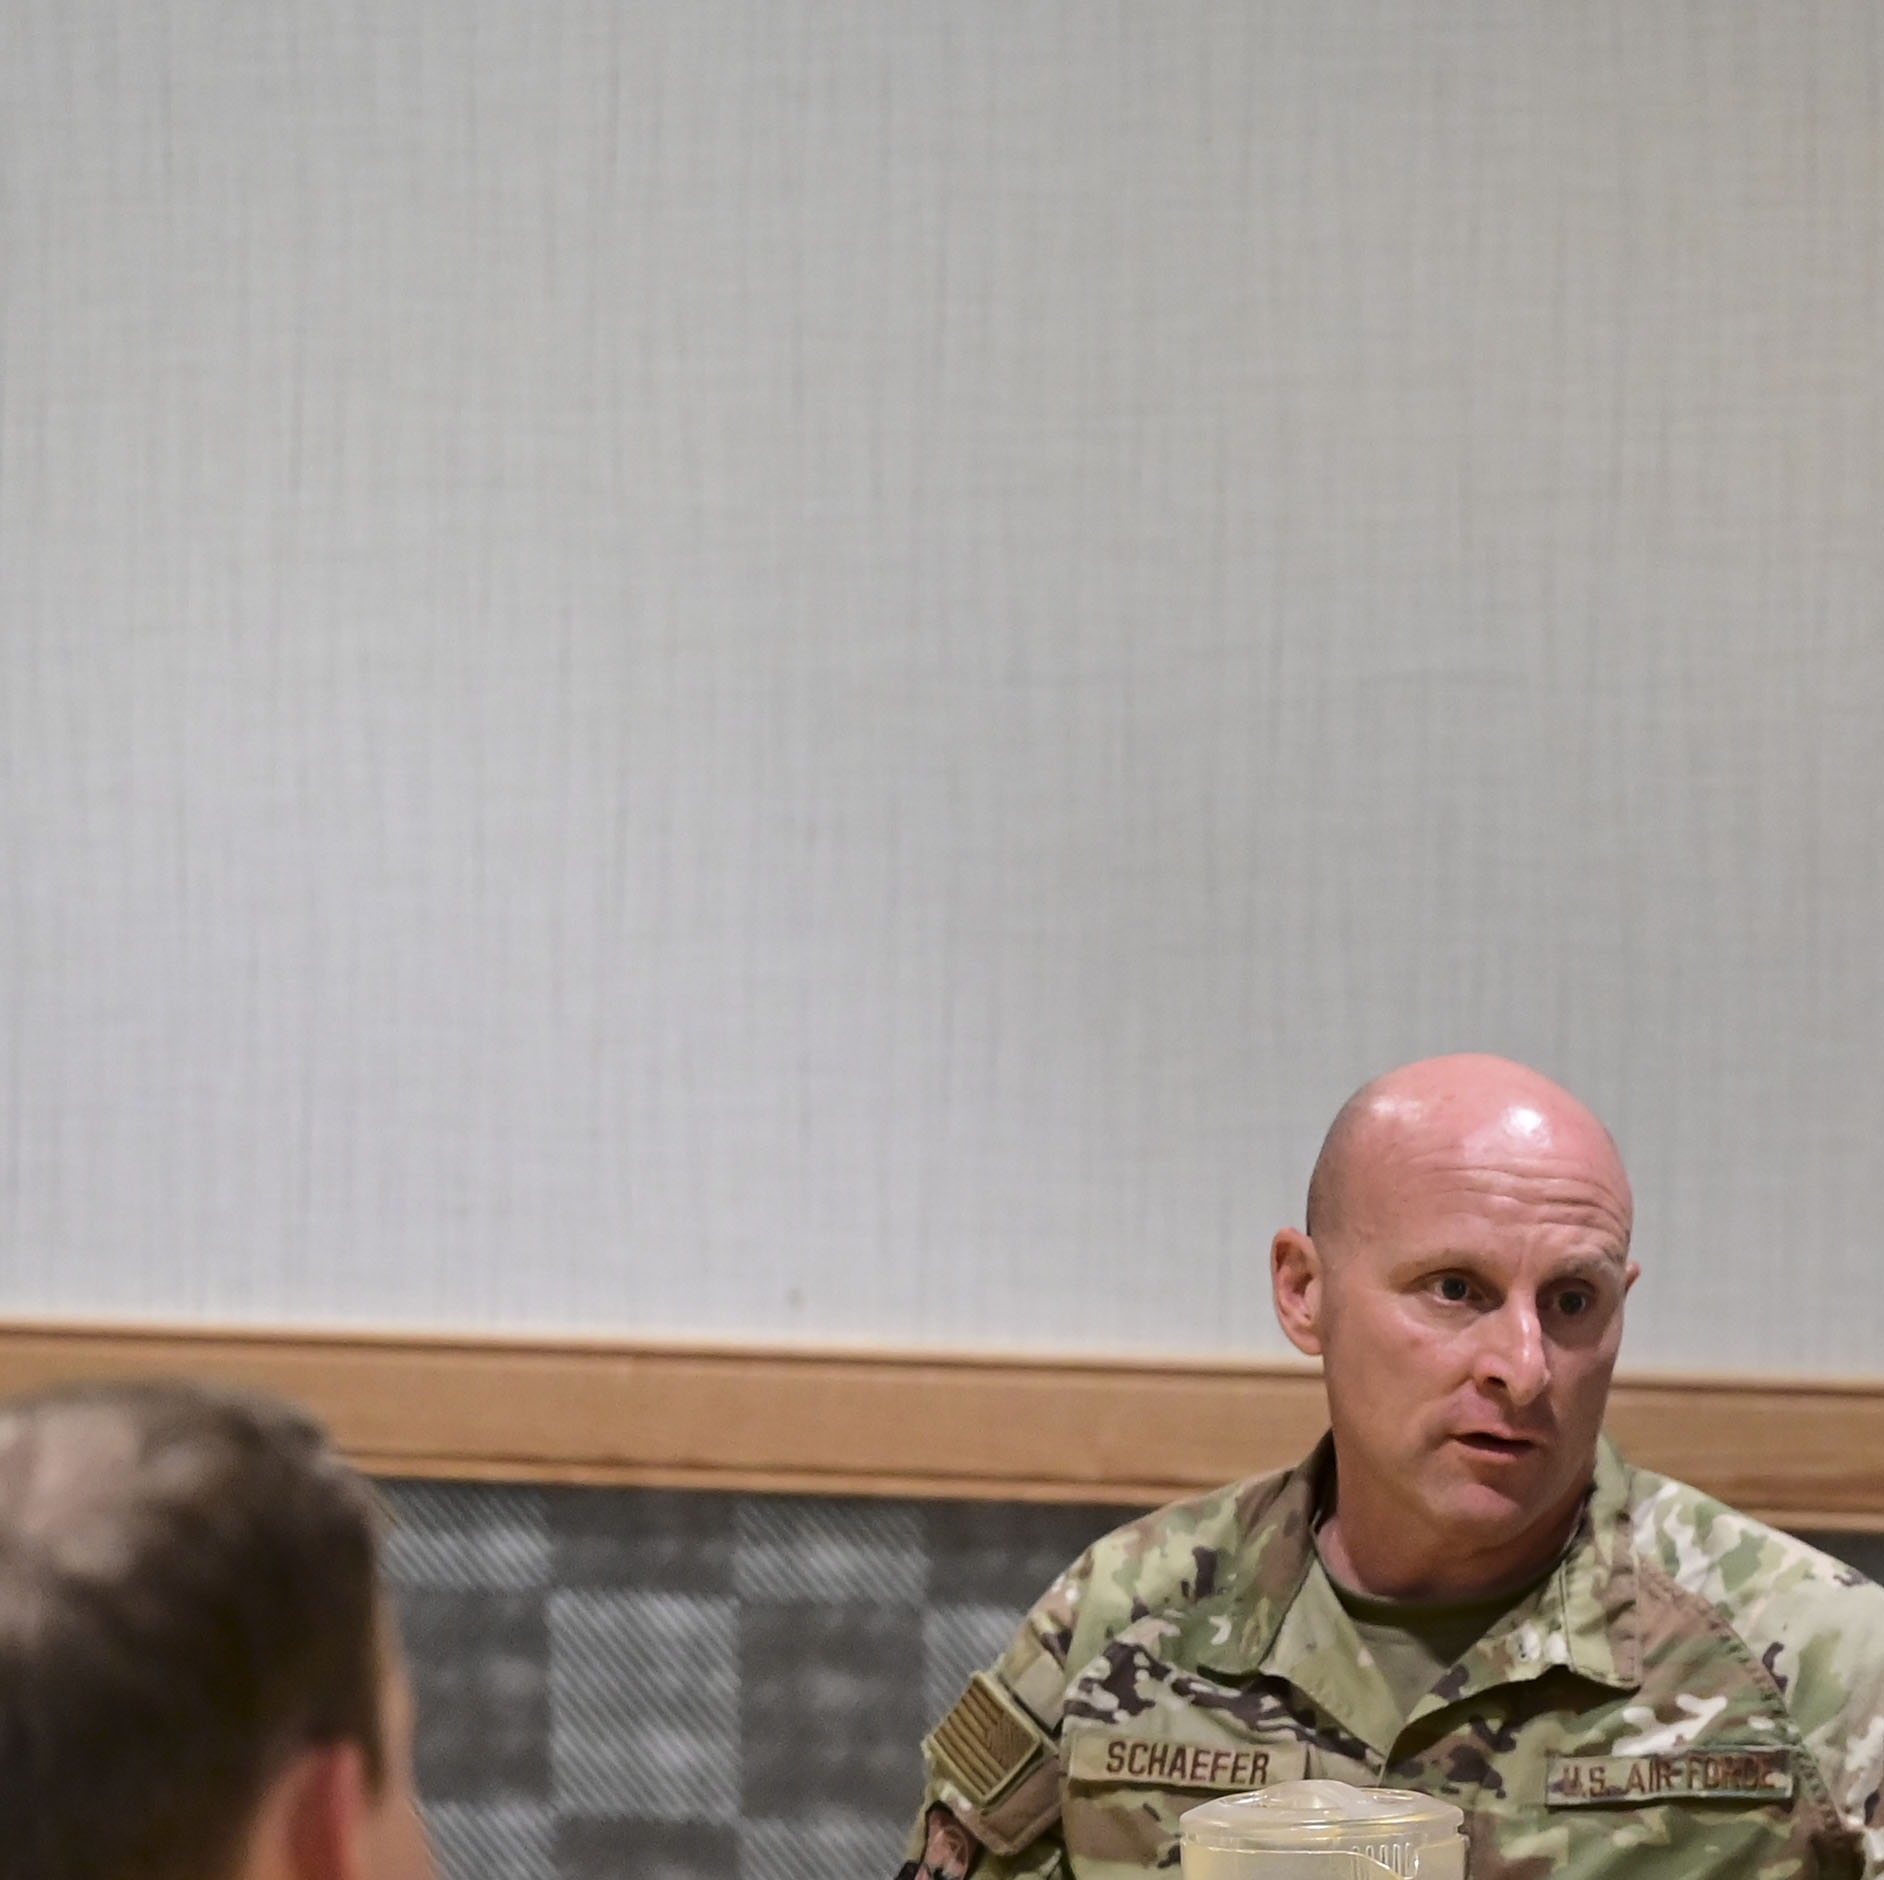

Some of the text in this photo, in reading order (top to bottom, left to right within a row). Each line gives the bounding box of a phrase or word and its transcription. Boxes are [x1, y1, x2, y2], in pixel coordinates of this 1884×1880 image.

[1105, 1740, 1270, 1785] SCHAEFER
[1625, 1757, 1673, 1794] AIR
[1686, 1755, 1776, 1791] FORCE
